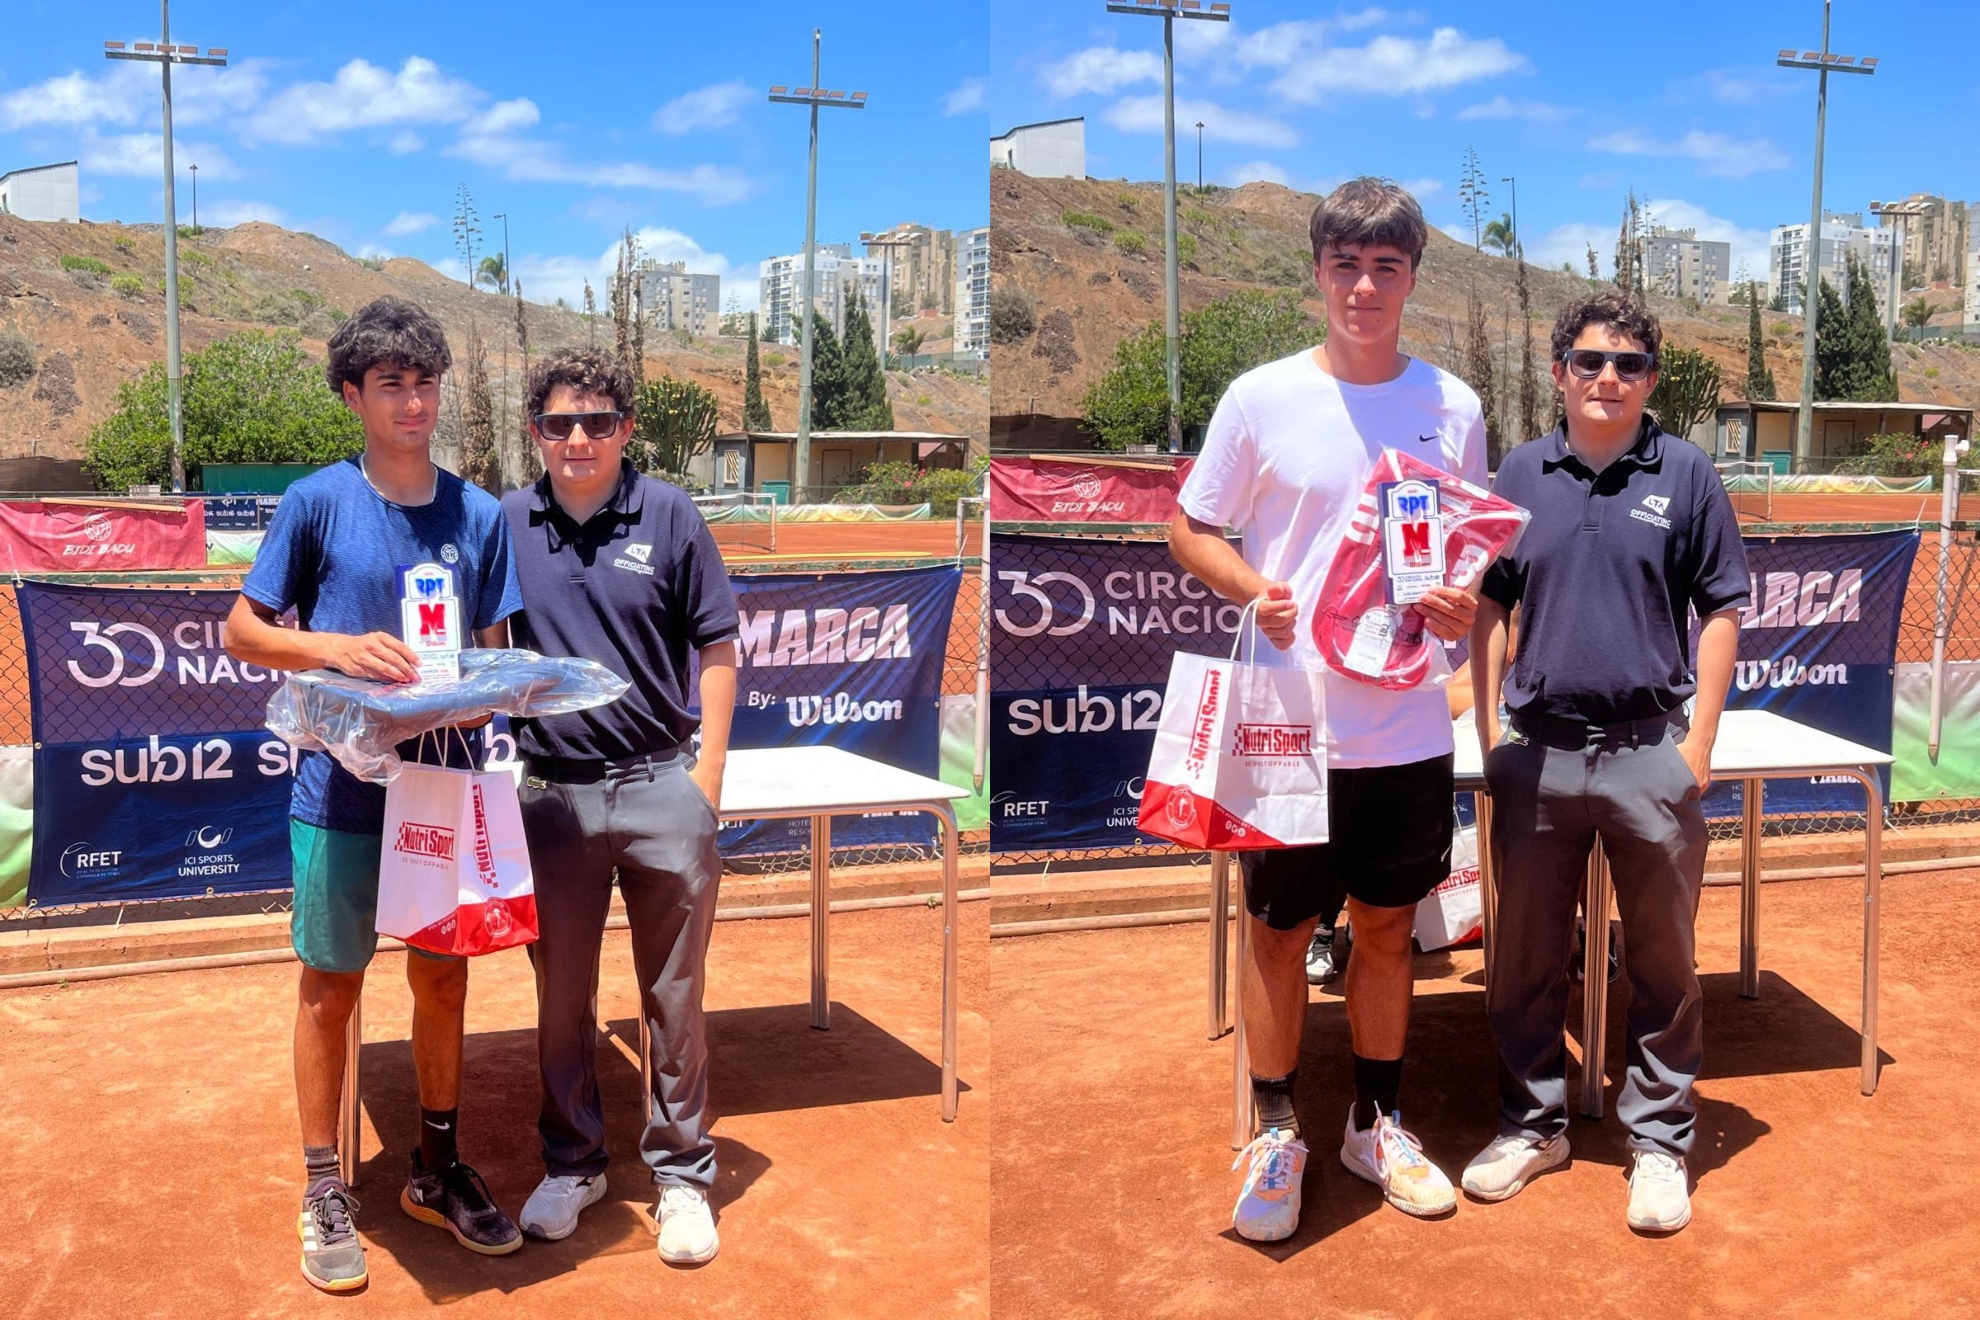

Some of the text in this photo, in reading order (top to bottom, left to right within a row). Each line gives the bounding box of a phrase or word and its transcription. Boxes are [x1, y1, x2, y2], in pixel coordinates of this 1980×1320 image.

[1051, 502, 1085, 512] BIDI
[1397, 495, 1429, 515] RPT
[63, 544, 96, 556] BIDI
[1402, 522, 1431, 556] M
[415, 578, 445, 597] RPT
[1738, 569, 1862, 629] ARCA
[419, 603, 447, 636] M
[735, 604, 911, 667] MARCA
[177, 654, 292, 685] NACI
[1735, 655, 1847, 691] Wilson
[748, 691, 903, 727] By: Wilson
[1008, 684, 1162, 736] sub12
[1243, 728, 1312, 757] NutriSport
[81, 734, 233, 787] sub12
[1004, 801, 1049, 817] RFET
[1113, 807, 1142, 816] ICI SP
[403, 826, 455, 857] NutriSport
[77, 851, 122, 868] RFET
[178, 863, 240, 877] UNIVERSITY
[184, 854, 234, 865] ICI SPORTS
